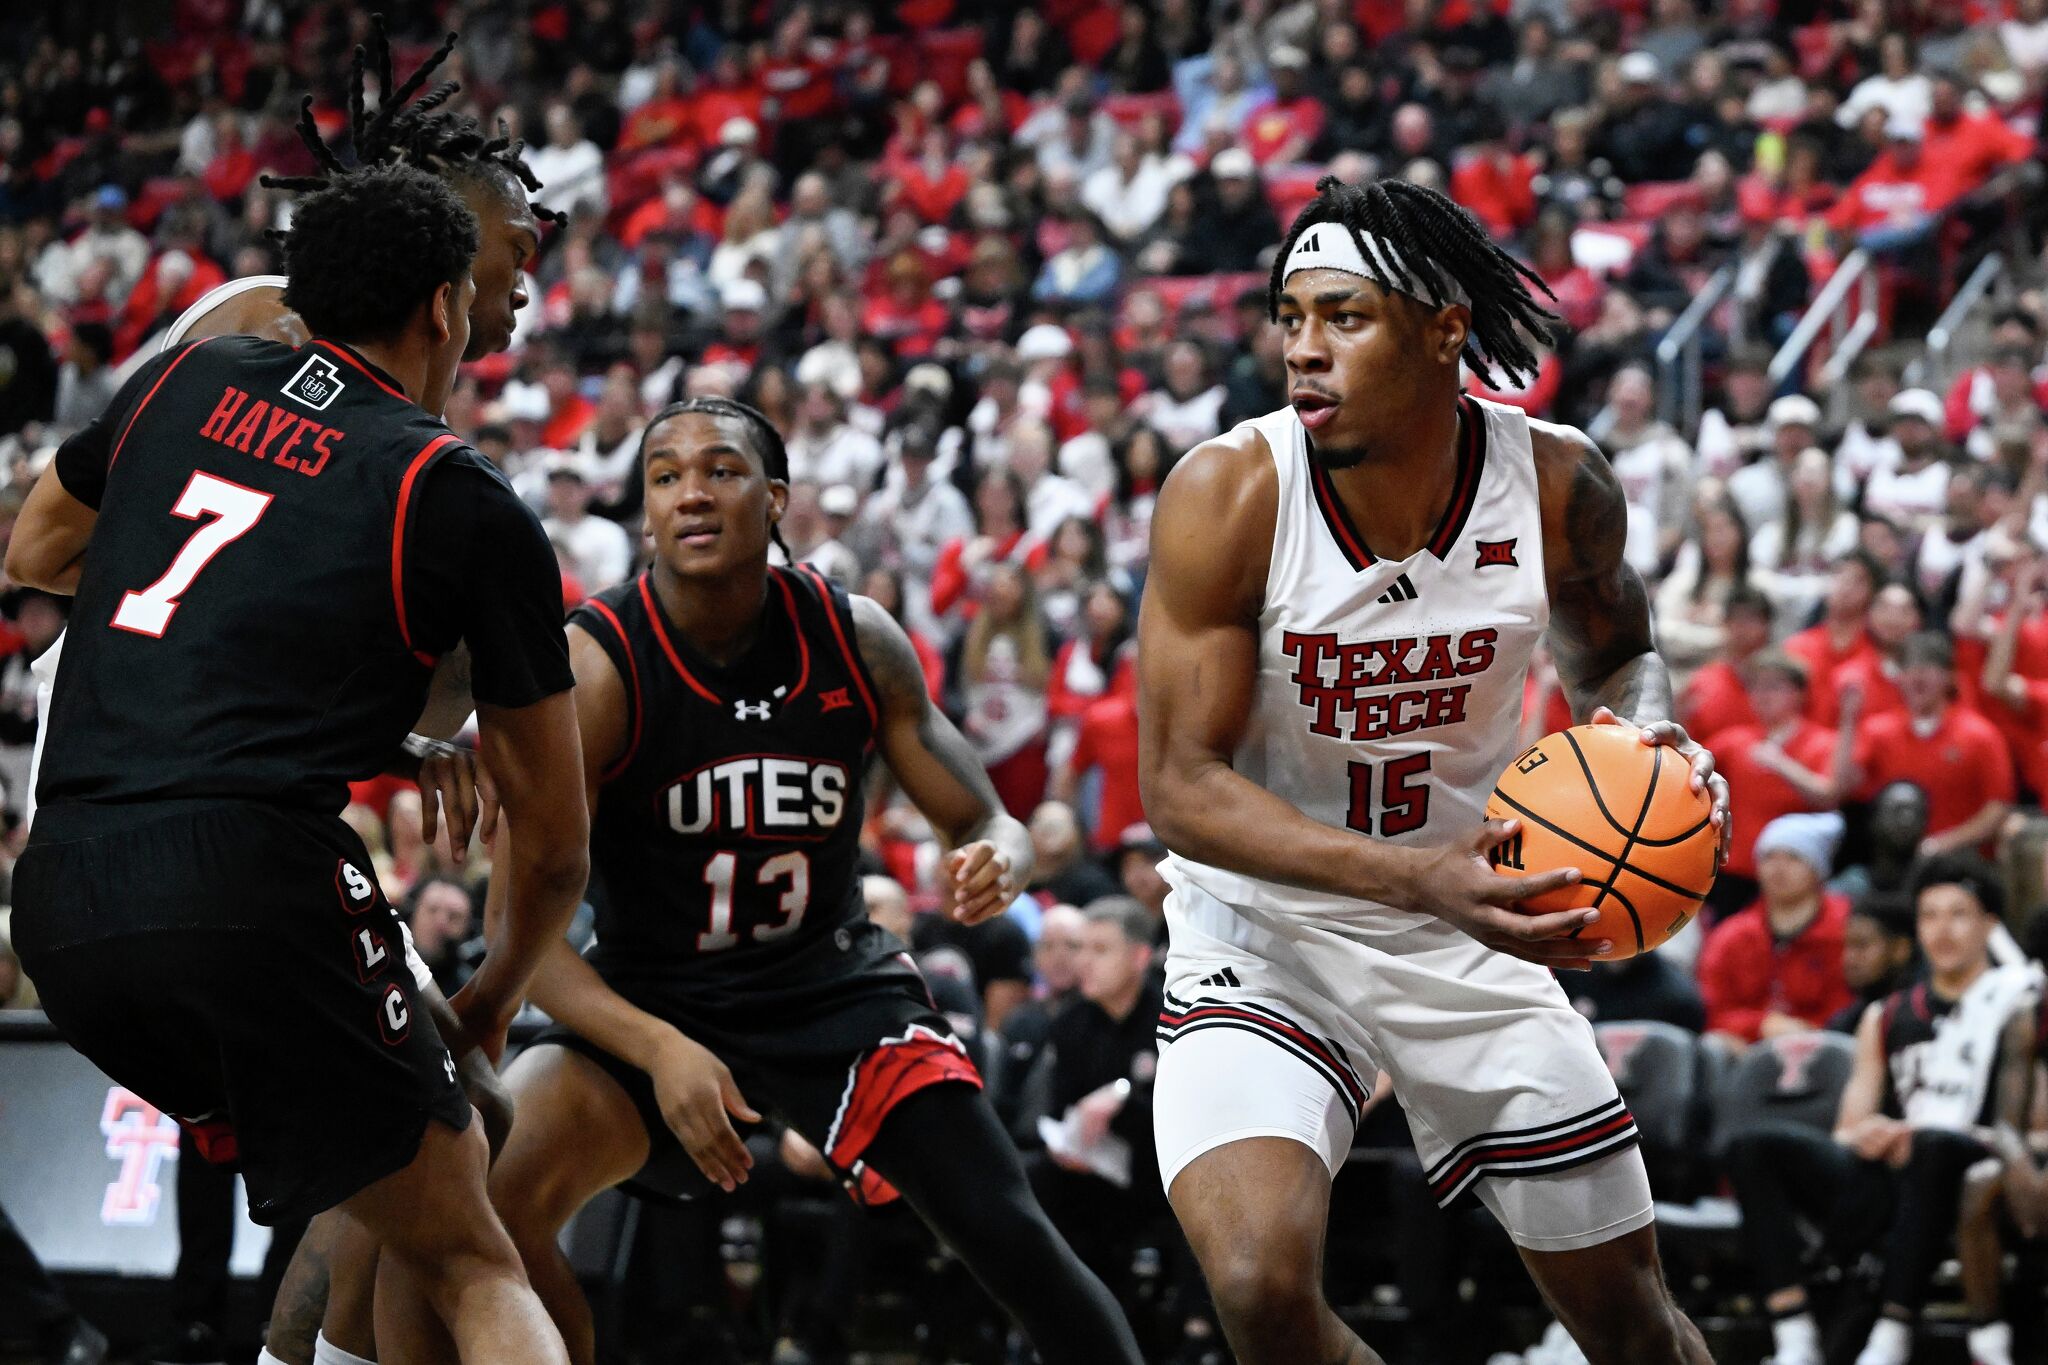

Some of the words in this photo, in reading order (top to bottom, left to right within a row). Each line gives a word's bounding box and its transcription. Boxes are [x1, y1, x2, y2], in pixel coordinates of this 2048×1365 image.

[199, 385, 346, 477] HAYES
[109, 469, 276, 639] 7
[1475, 537, 1519, 569] XII
[1281, 627, 1499, 688] TEXAS
[1299, 683, 1472, 742] TECH
[668, 757, 847, 835] UTES
[1345, 750, 1432, 838] 15
[696, 850, 811, 952] 13
